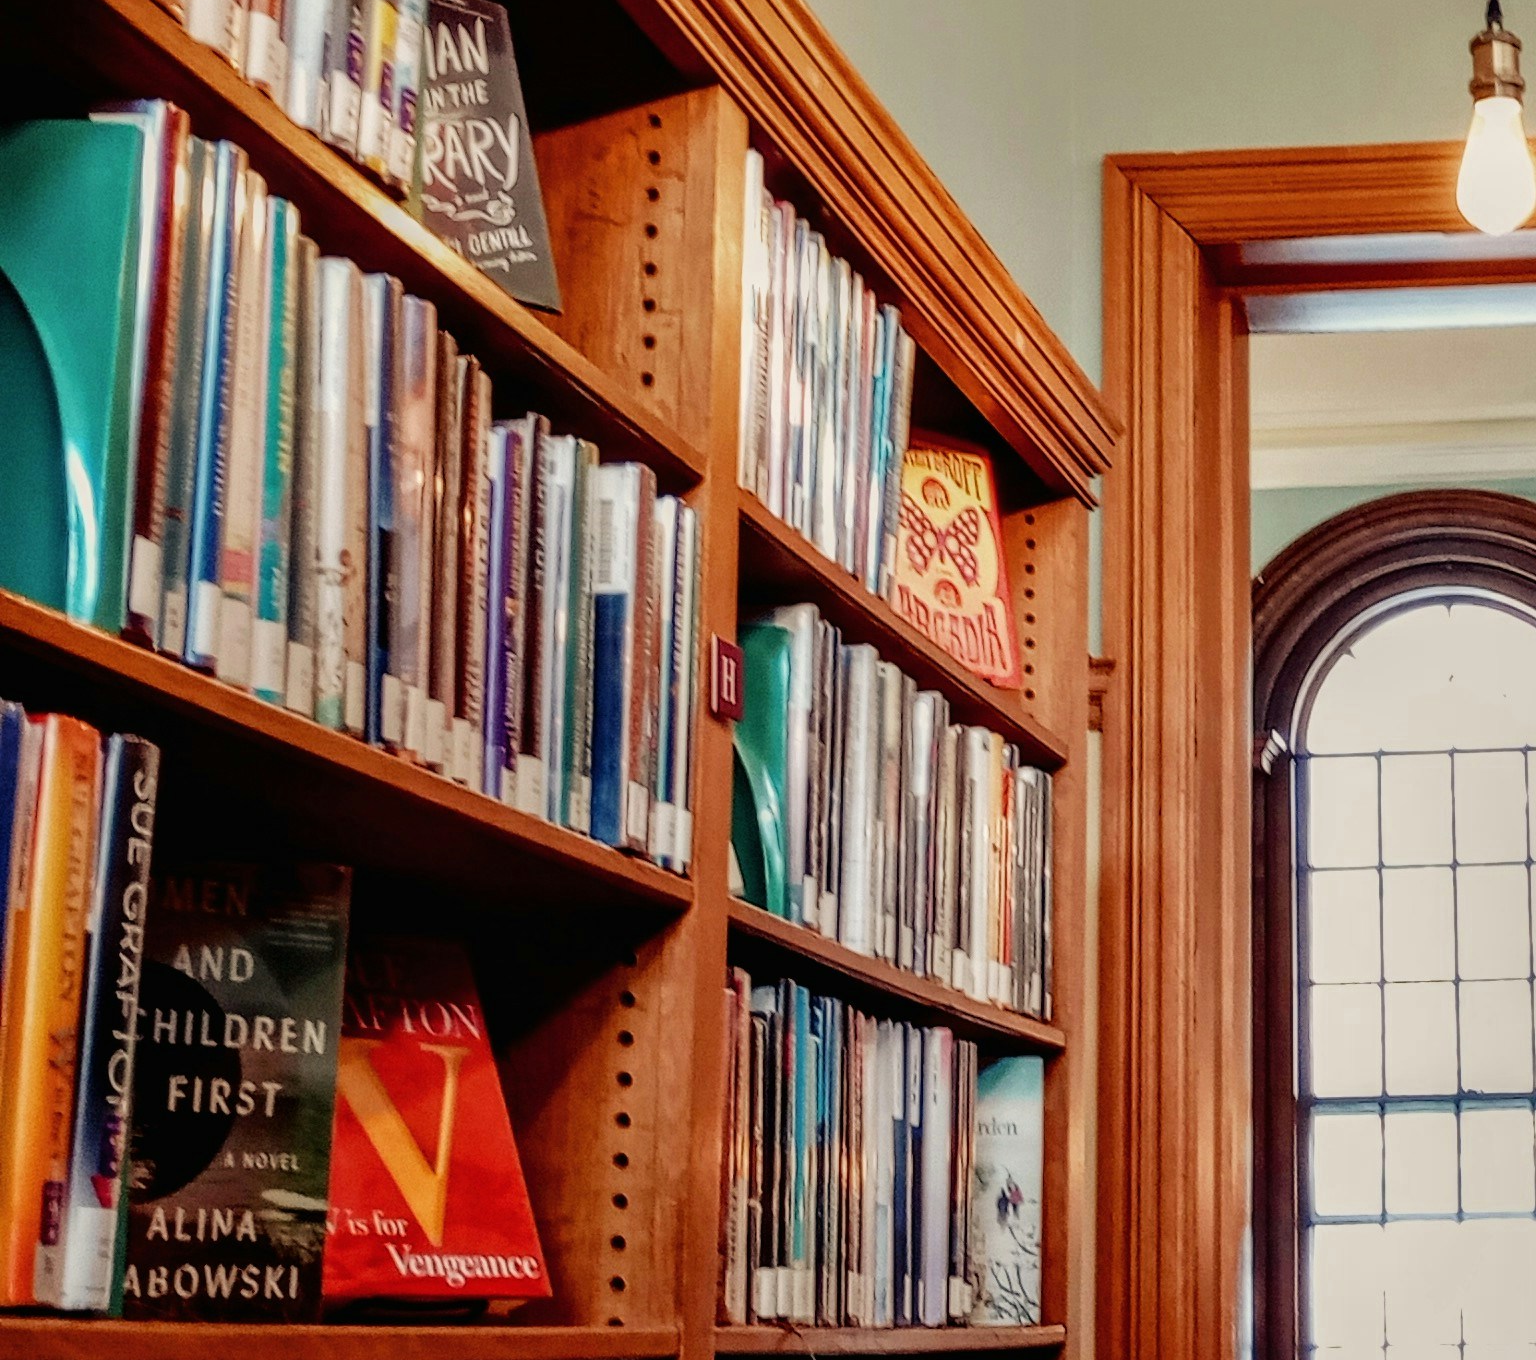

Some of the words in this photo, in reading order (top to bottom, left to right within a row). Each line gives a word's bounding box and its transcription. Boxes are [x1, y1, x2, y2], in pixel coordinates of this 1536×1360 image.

[446, 78, 489, 109] THE
[721, 653, 737, 706] H
[127, 768, 156, 866] SUE
[175, 942, 256, 982] AND
[139, 1007, 328, 1056] HILDREN
[166, 1073, 284, 1119] FIRST
[224, 1152, 235, 1170] A
[241, 1153, 301, 1174] NOVEL
[145, 1205, 259, 1243] ALINA
[372, 1208, 409, 1237] for
[123, 1261, 300, 1301] ABOWSKI
[384, 1241, 541, 1291] Vengeance
